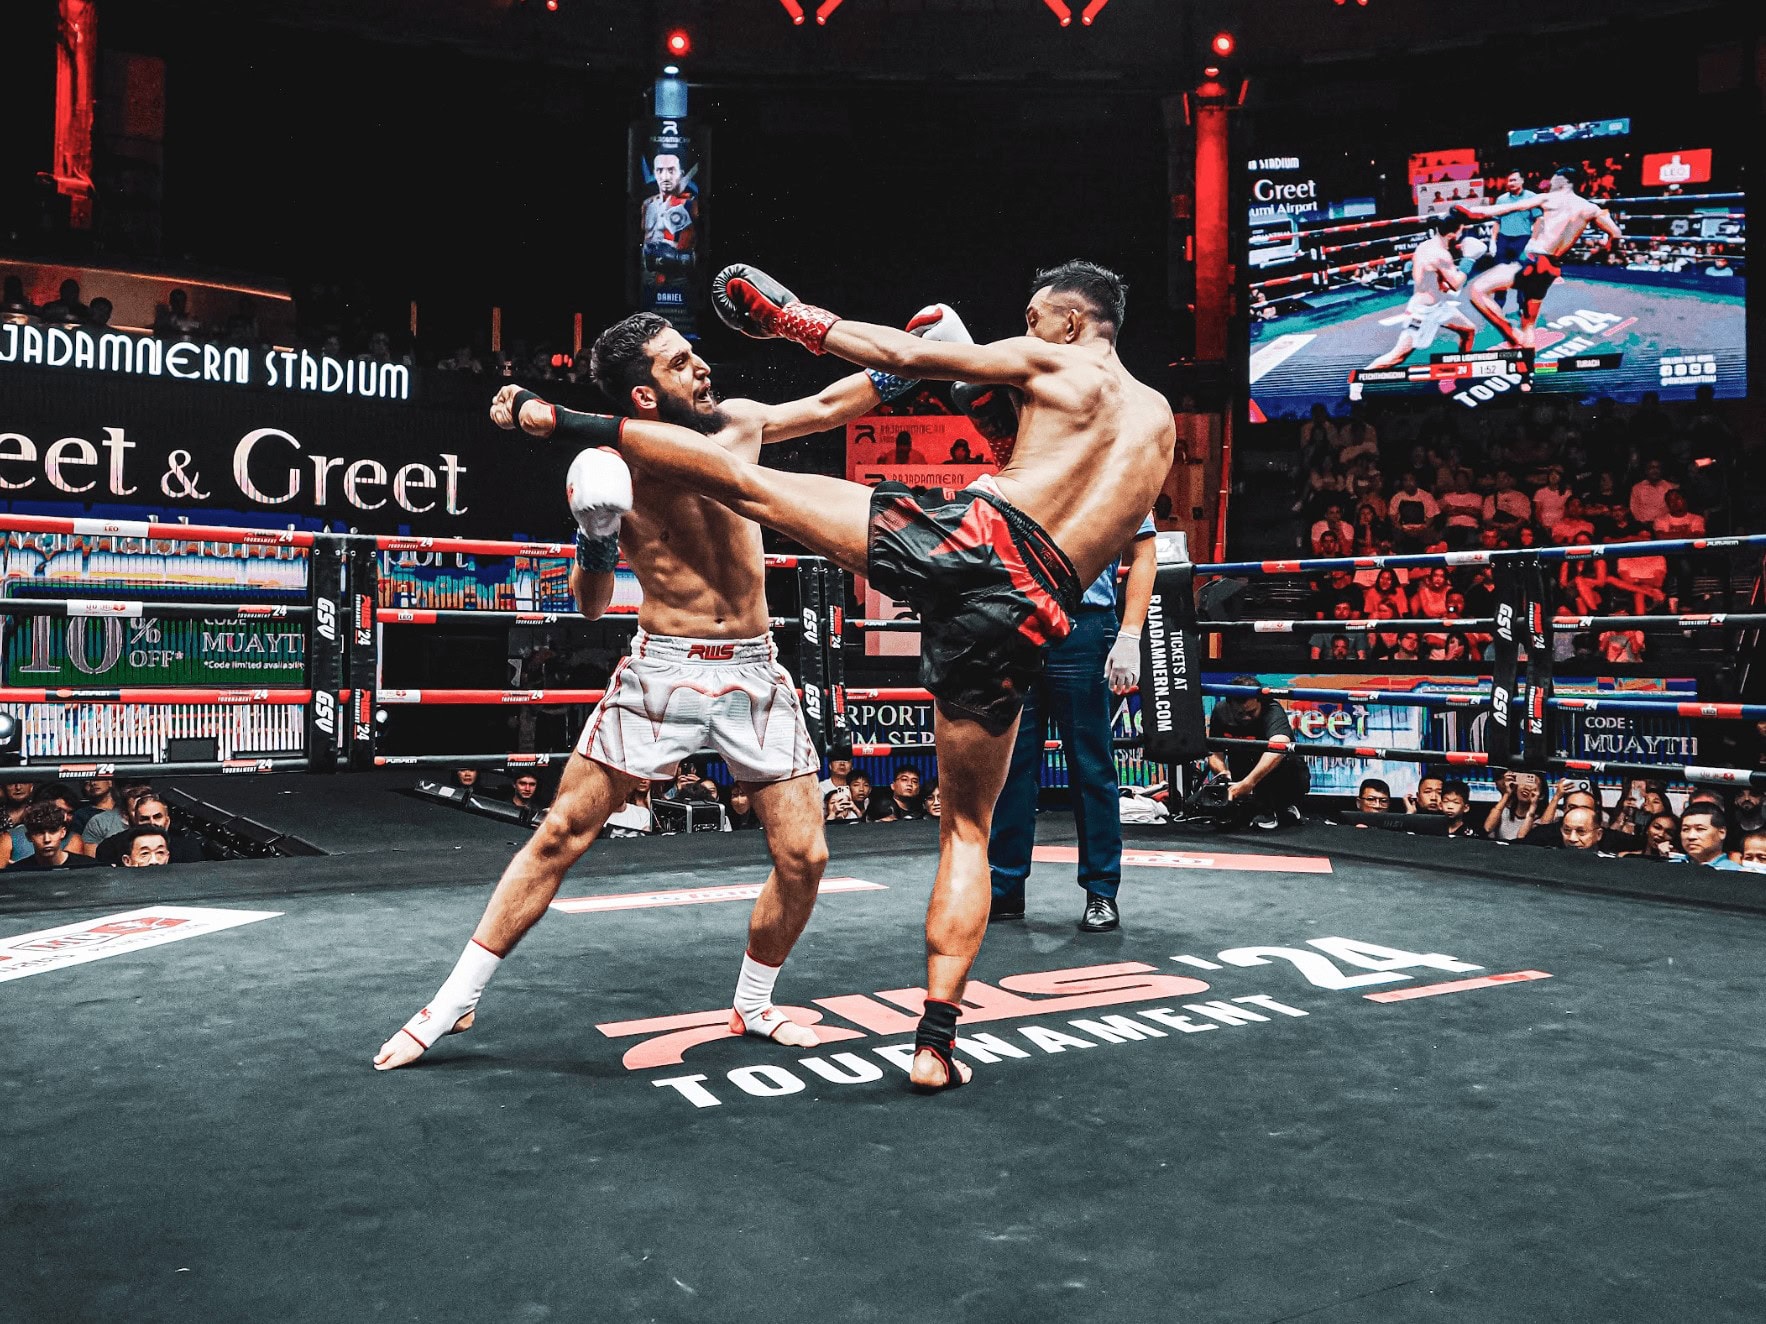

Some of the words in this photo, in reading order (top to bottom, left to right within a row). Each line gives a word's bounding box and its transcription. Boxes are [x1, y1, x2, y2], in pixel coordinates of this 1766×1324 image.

[1259, 157, 1300, 170] STADIUM
[1663, 167, 1686, 177] LEO
[1253, 178, 1317, 201] Greet
[1277, 200, 1318, 215] Airport
[657, 292, 683, 302] DANIEL
[0, 323, 249, 384] JADAMNERN
[265, 348, 409, 400] STADIUM
[160, 449, 211, 501] &
[233, 427, 469, 516] Greet
[317, 597, 336, 641] GSV
[803, 607, 819, 645] GSV
[1497, 602, 1513, 642] GSV
[687, 643, 735, 661] RWS
[1147, 594, 1173, 732] RAJADAMNERN.COM
[1170, 629, 1186, 675] TICKETS
[804, 682, 821, 720] GSV
[1173, 677, 1188, 691] AT
[314, 689, 335, 735] GSV
[1492, 686, 1509, 727] GSV
[1584, 716, 1626, 729] CODE
[1583, 733, 1699, 756] MUAYTH
[1169, 936, 1486, 990] '24
